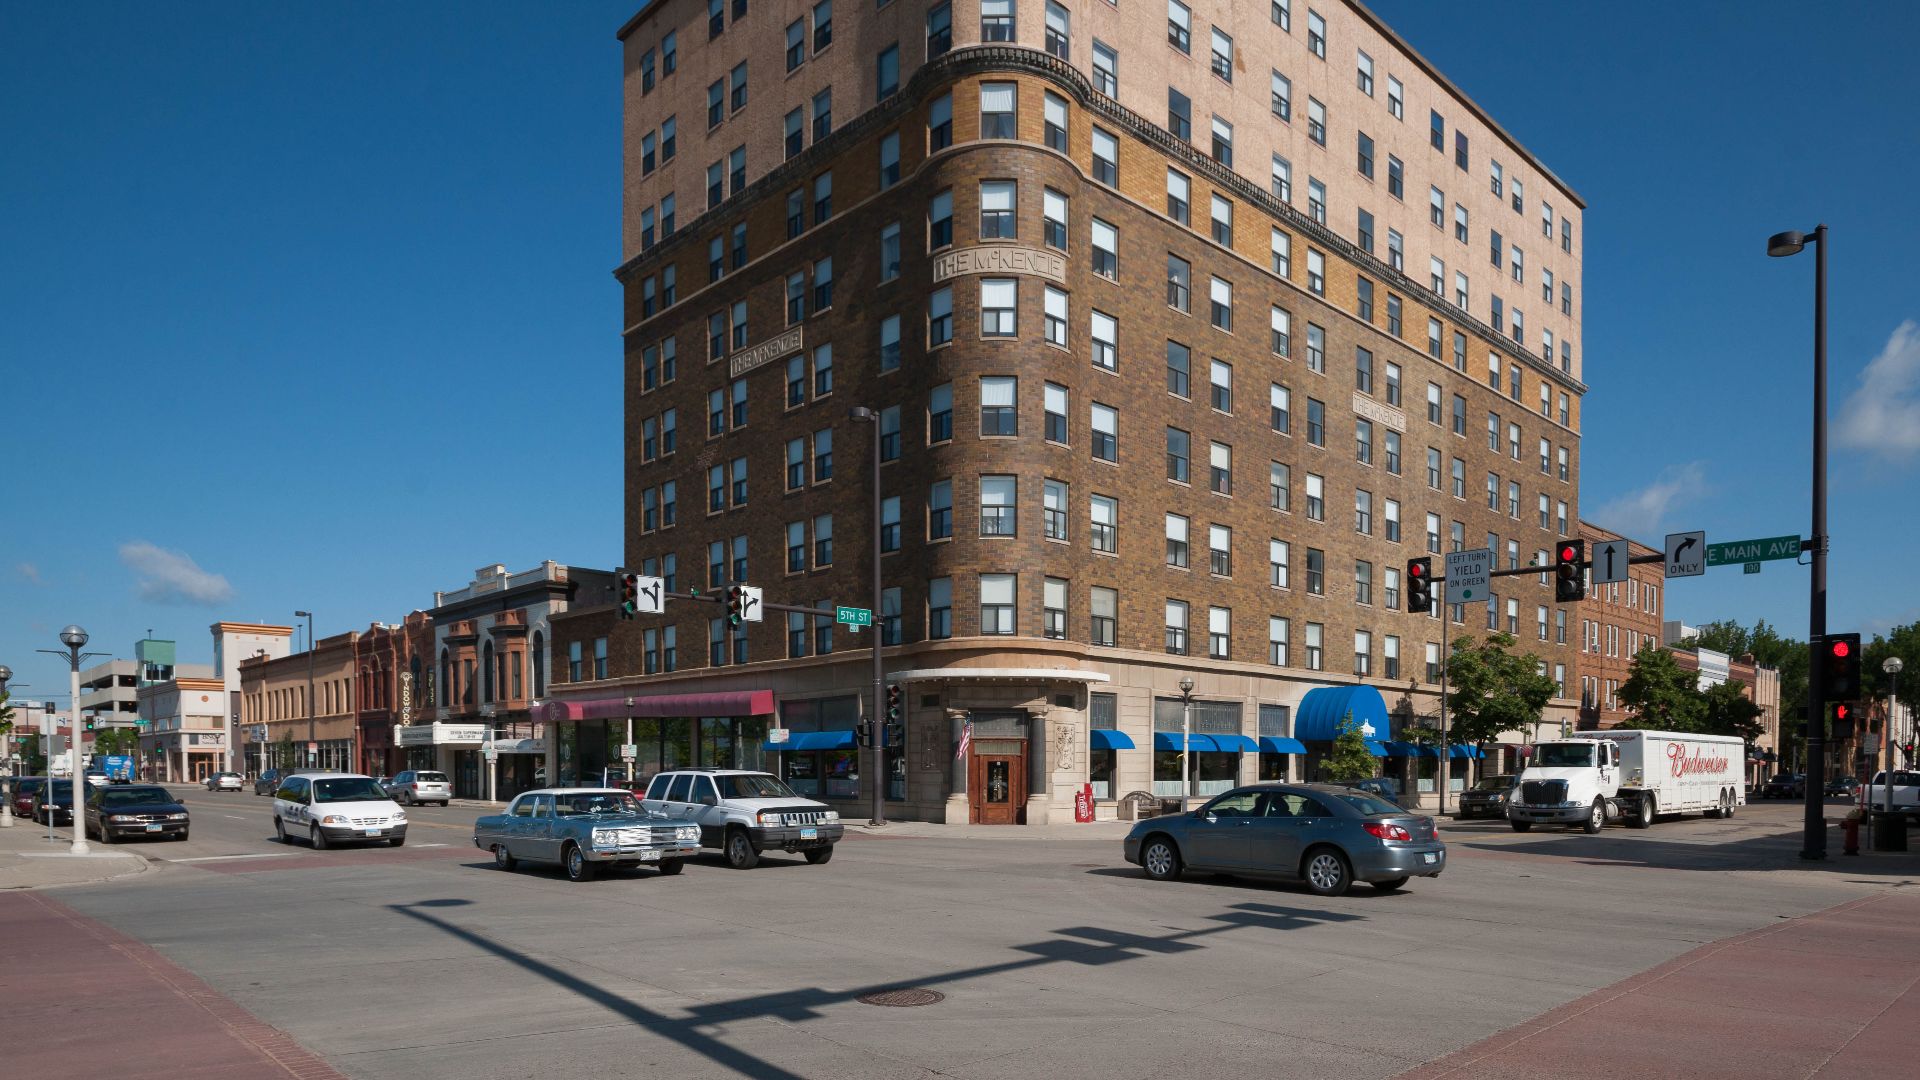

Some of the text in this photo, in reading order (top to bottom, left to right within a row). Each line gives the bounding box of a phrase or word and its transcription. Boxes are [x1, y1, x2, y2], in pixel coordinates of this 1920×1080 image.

[935, 253, 969, 281] THE
[733, 353, 751, 373] THE
[1354, 396, 1369, 416] THE
[1449, 552, 1487, 564] LEFT TURN
[1708, 540, 1798, 561] E MAIN AVE
[1454, 564, 1481, 576] YIELD
[1671, 563, 1698, 574] ONLY
[1450, 577, 1485, 588] ON GREEN
[841, 611, 867, 621] 5TH ST
[402, 677, 411, 706] WINDOW
[1667, 743, 1729, 778] Budweiser
